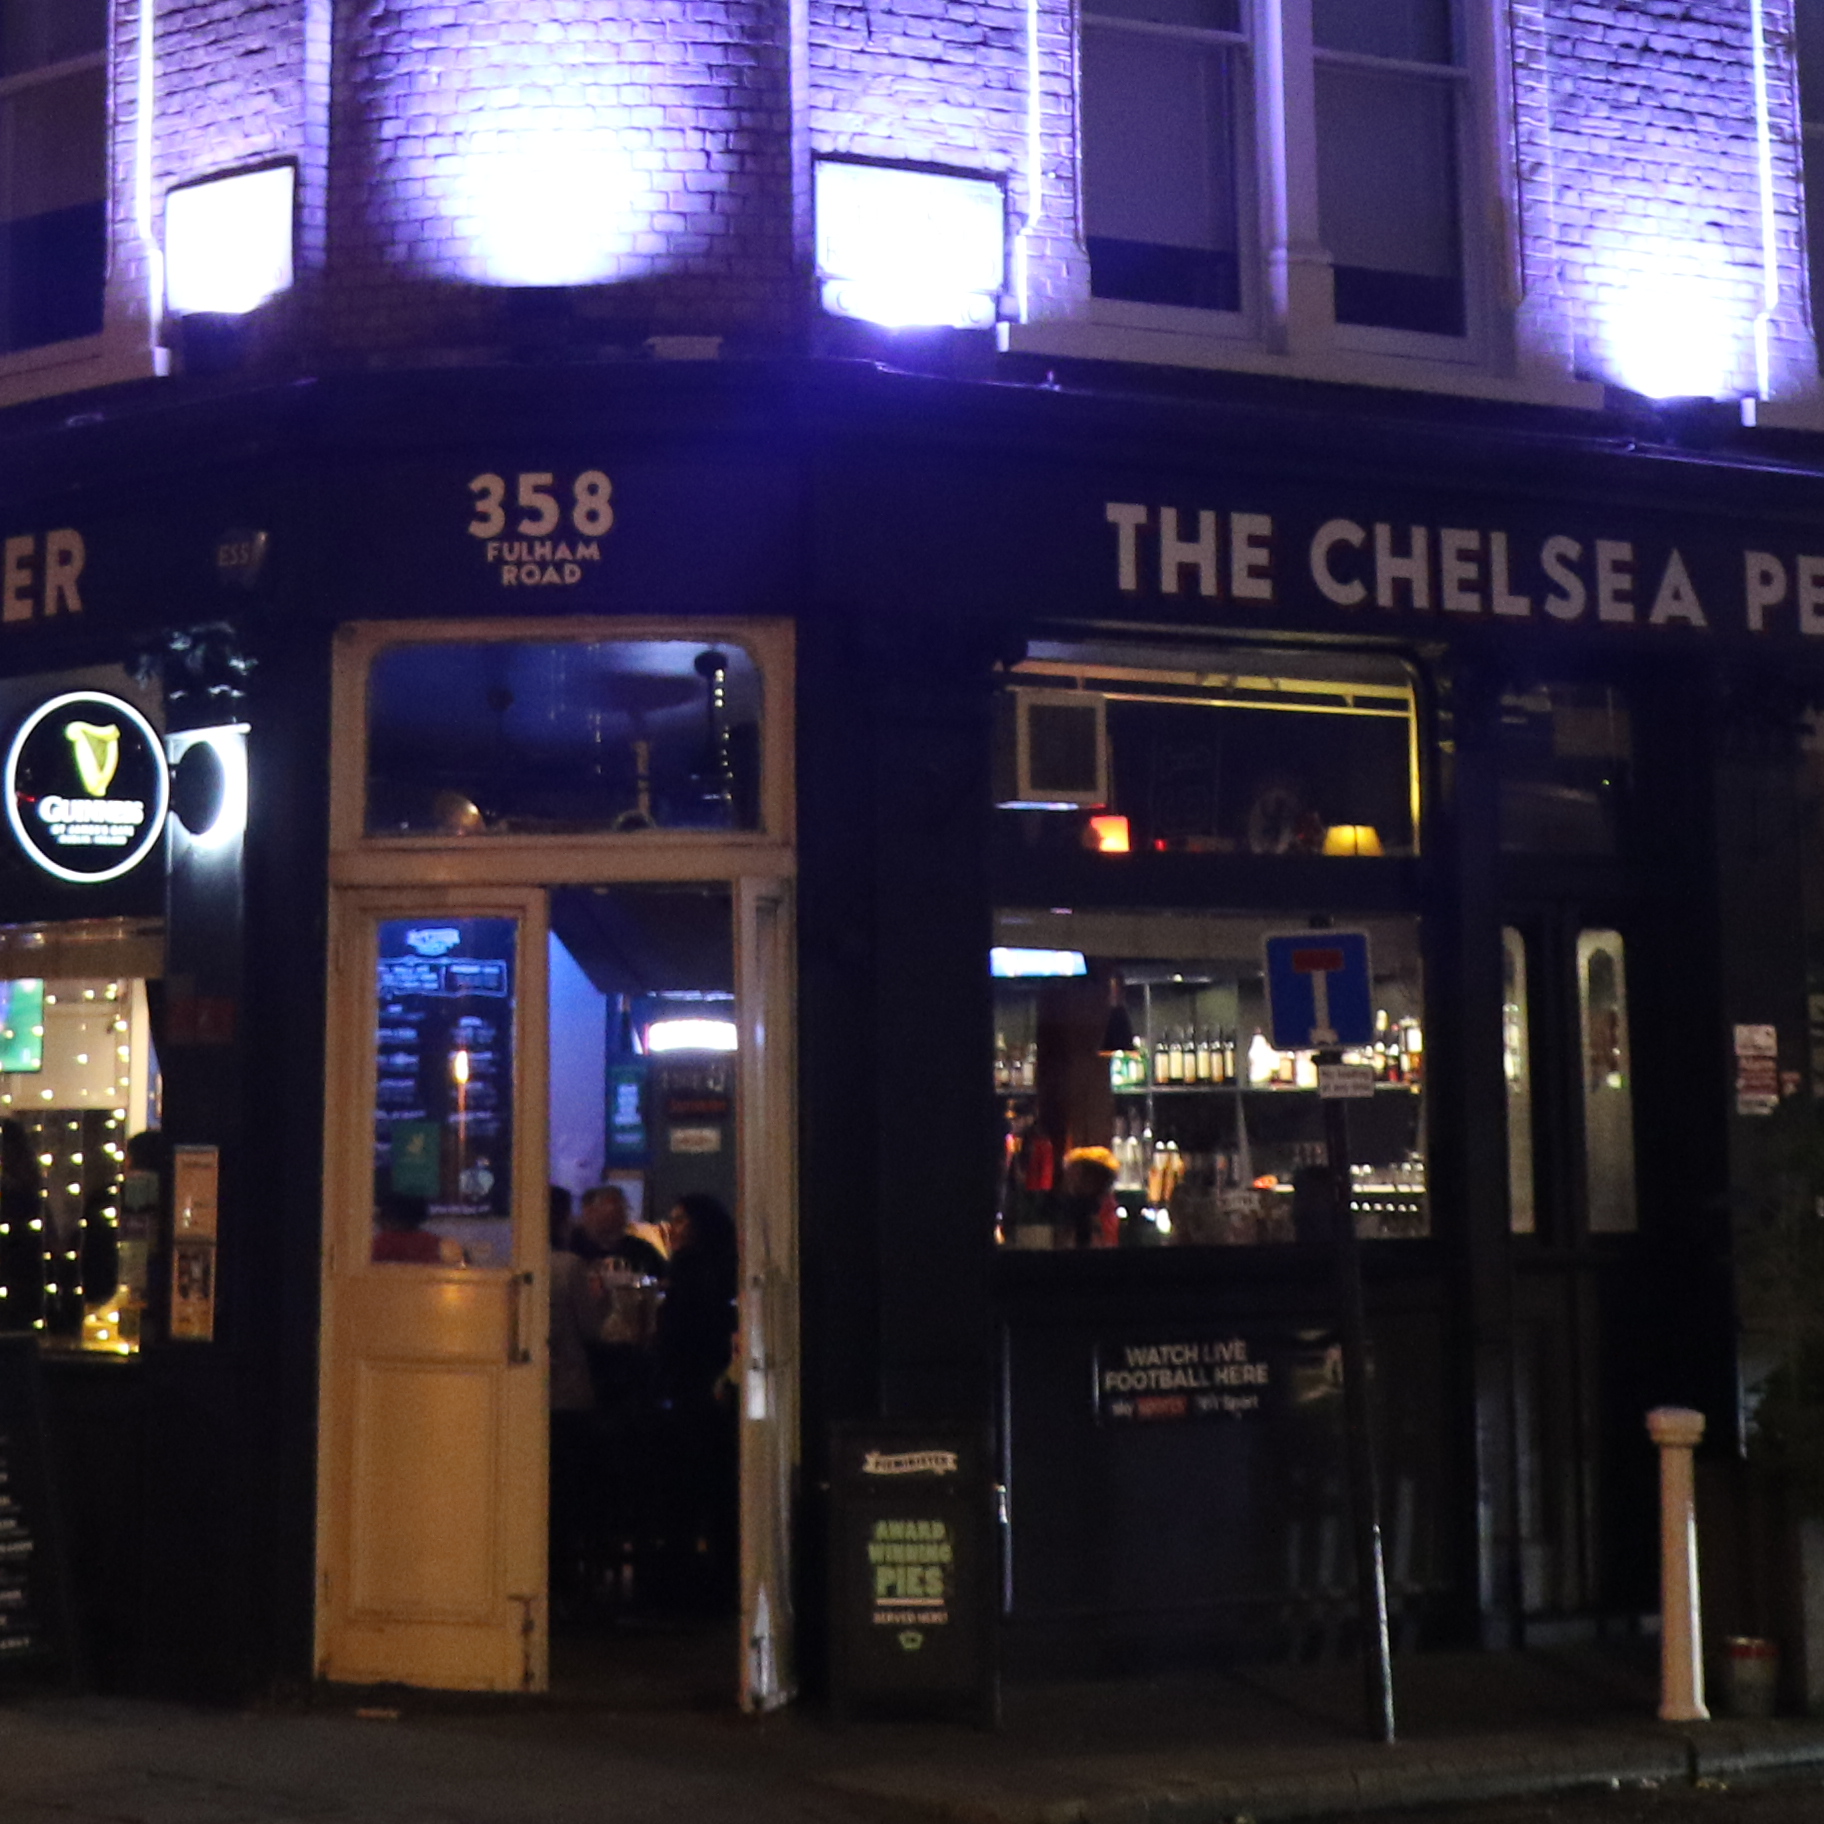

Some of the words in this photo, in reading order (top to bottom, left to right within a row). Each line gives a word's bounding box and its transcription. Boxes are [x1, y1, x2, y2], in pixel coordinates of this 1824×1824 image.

[467, 469, 616, 539] 358
[486, 541, 601, 563] FULHAM
[1102, 501, 1274, 601] THE
[1309, 516, 1709, 627] CHELSEA
[501, 564, 584, 587] ROAD
[1124, 1343, 1199, 1367] WATCH
[1204, 1338, 1248, 1362] LIVE
[1104, 1367, 1210, 1392] FOOTBALL
[1214, 1362, 1270, 1385] HERE
[875, 1519, 946, 1540] AWARD
[868, 1543, 953, 1564] WINNING
[876, 1566, 945, 1597] PIES
